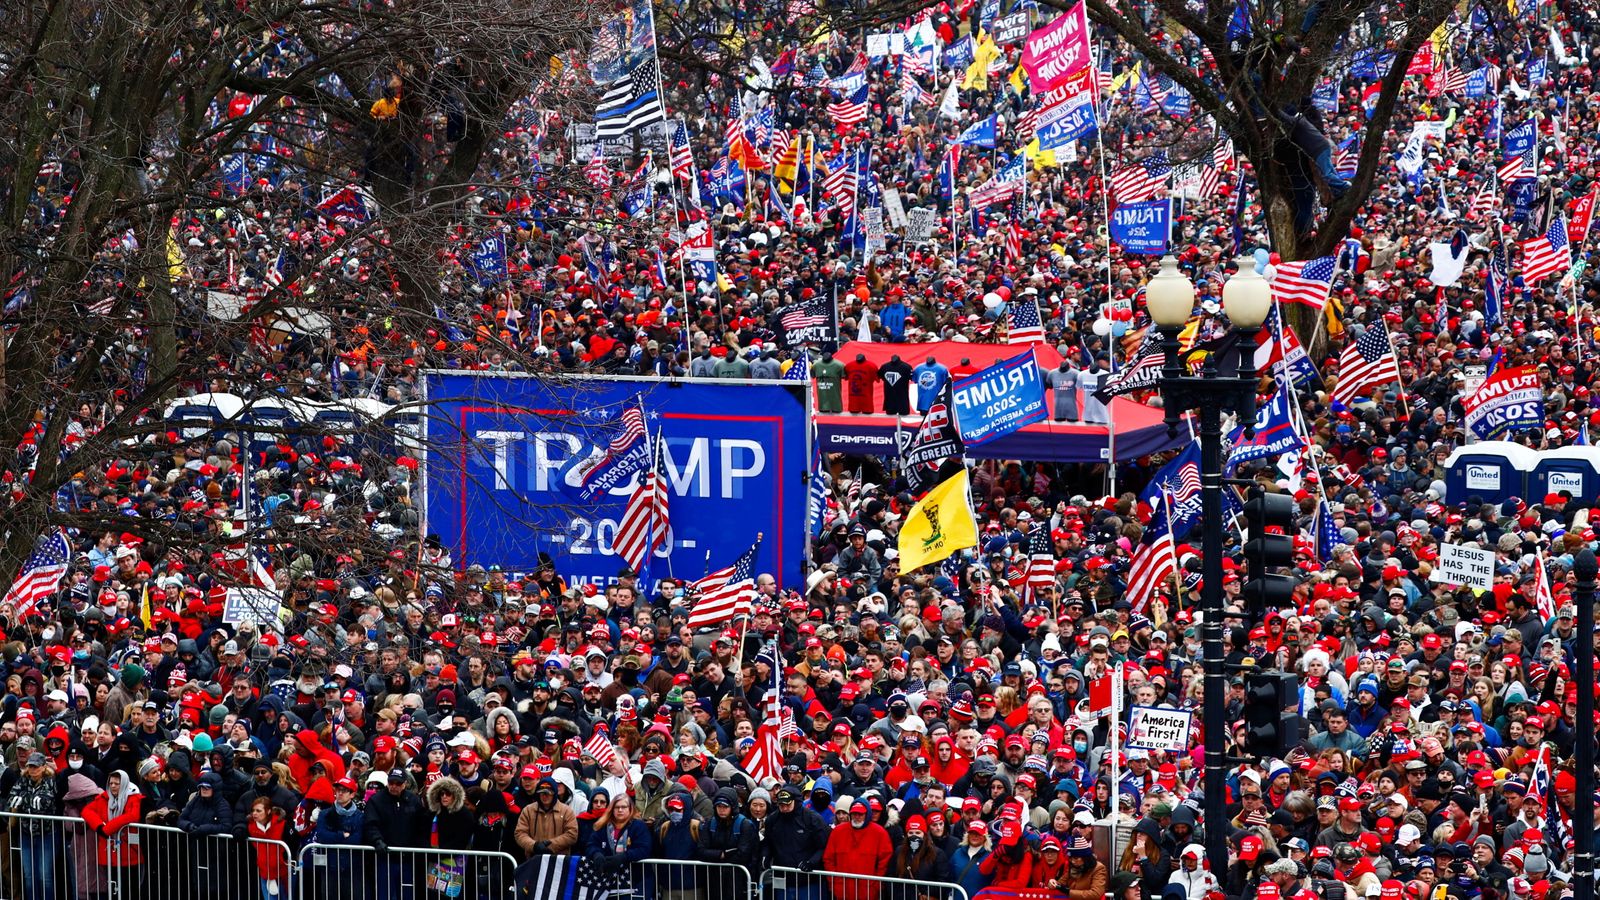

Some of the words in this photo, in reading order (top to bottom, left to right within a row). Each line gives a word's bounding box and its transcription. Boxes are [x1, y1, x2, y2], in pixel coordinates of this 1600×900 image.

[908, 218, 932, 226] TRUMP
[830, 434, 893, 444] CAMPAIGN
[921, 444, 957, 461] GREAT!
[474, 430, 765, 498] TRMP
[1470, 470, 1498, 479] United
[1552, 477, 1580, 486] United
[552, 516, 696, 558] -20-
[1450, 548, 1484, 562] JESUS
[1442, 559, 1464, 570] HAS
[1470, 564, 1490, 575] THE
[557, 573, 663, 596] MERCA
[1445, 572, 1485, 586] THRONE
[232, 596, 278, 609] TRUMP
[1141, 712, 1185, 728] America
[1148, 725, 1180, 740] First!
